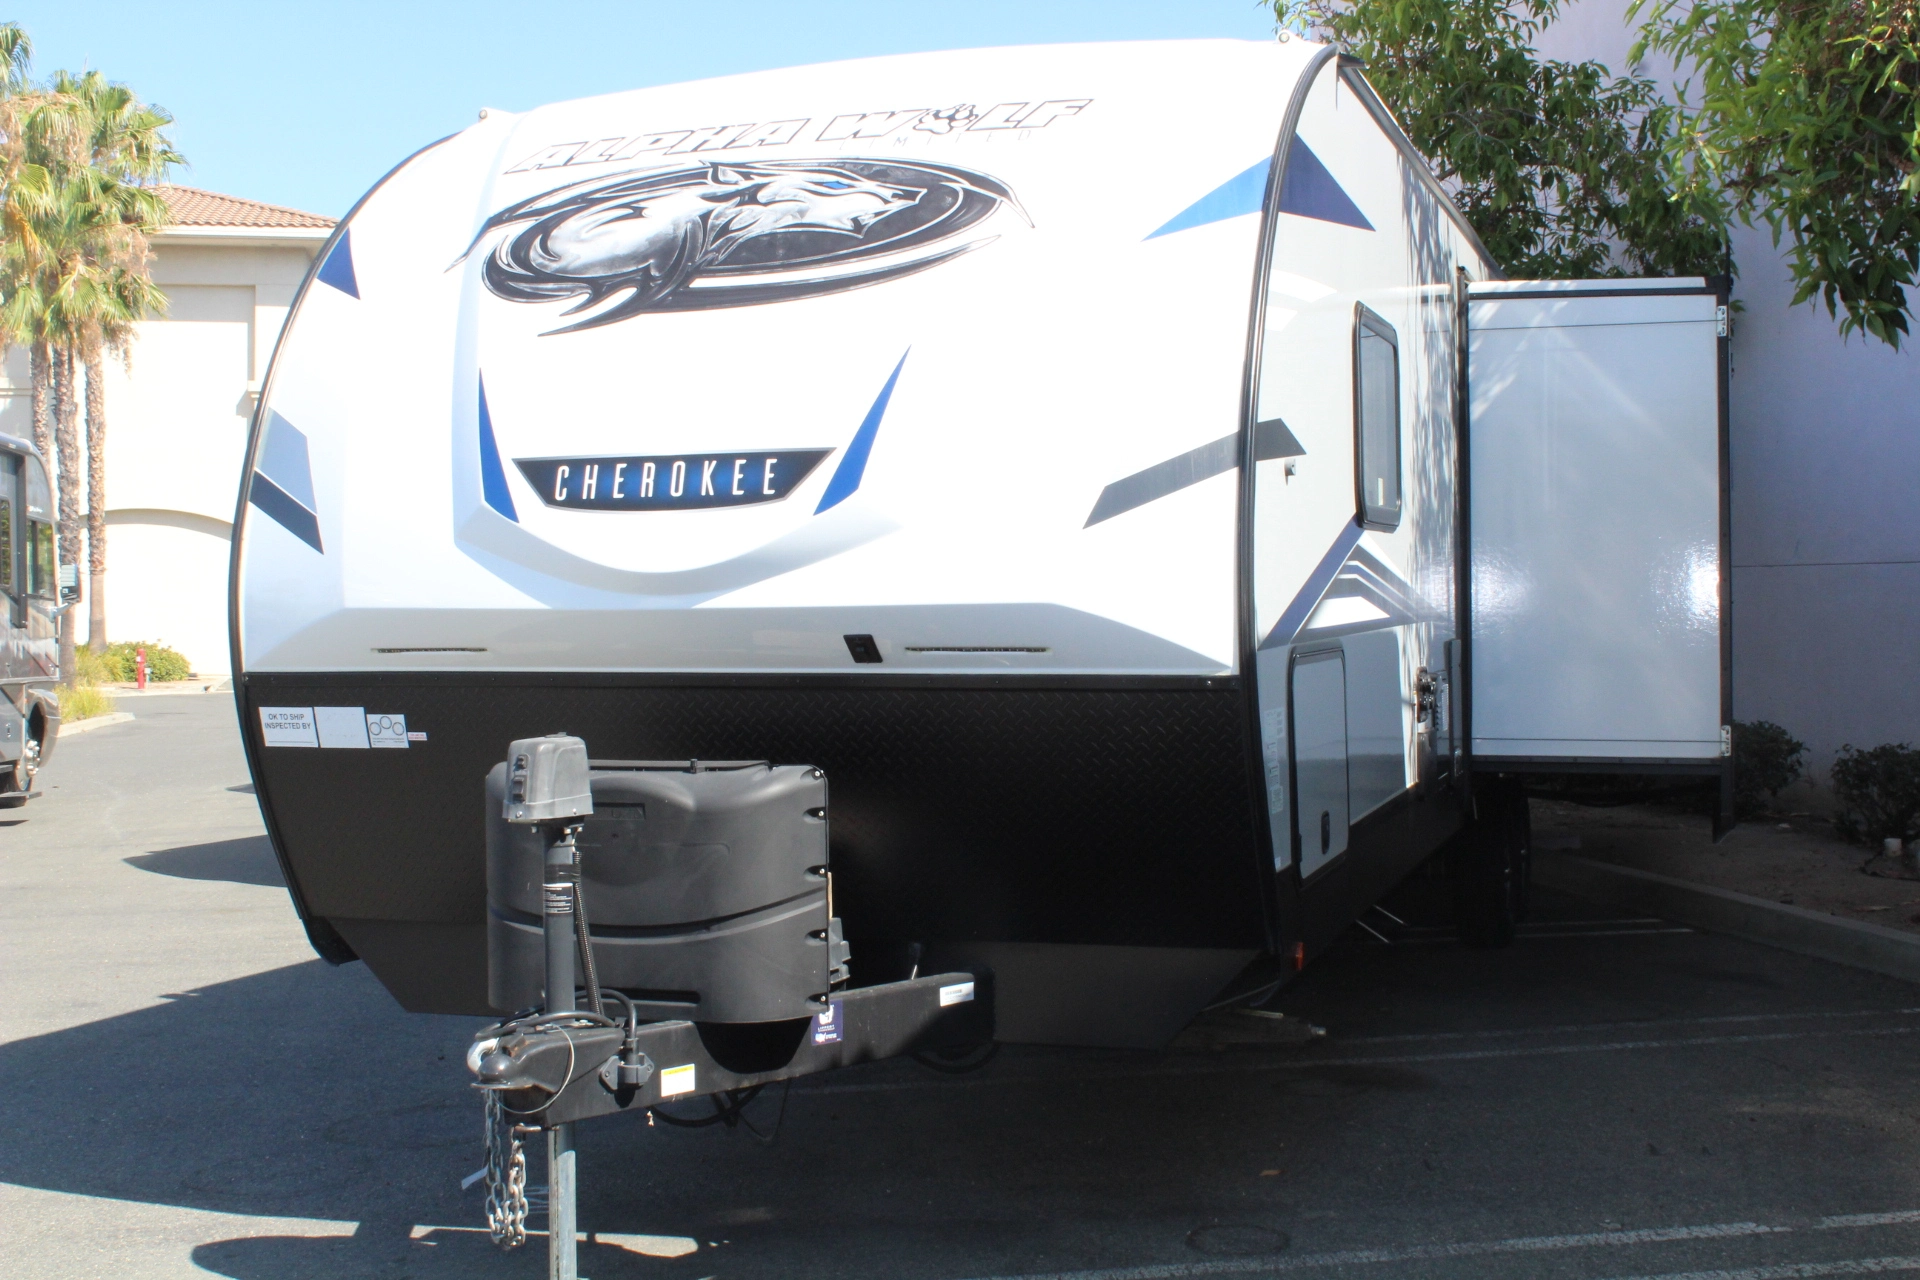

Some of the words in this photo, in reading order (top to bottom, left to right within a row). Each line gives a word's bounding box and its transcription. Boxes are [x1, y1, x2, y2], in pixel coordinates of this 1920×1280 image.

[503, 118, 811, 174] ALPHA
[554, 458, 778, 501] CHEROKEE
[264, 722, 301, 730] INSPECTED
[301, 722, 311, 730] BY
[268, 713, 278, 721] OK
[279, 713, 289, 721] TO
[290, 713, 305, 721] SHIP
